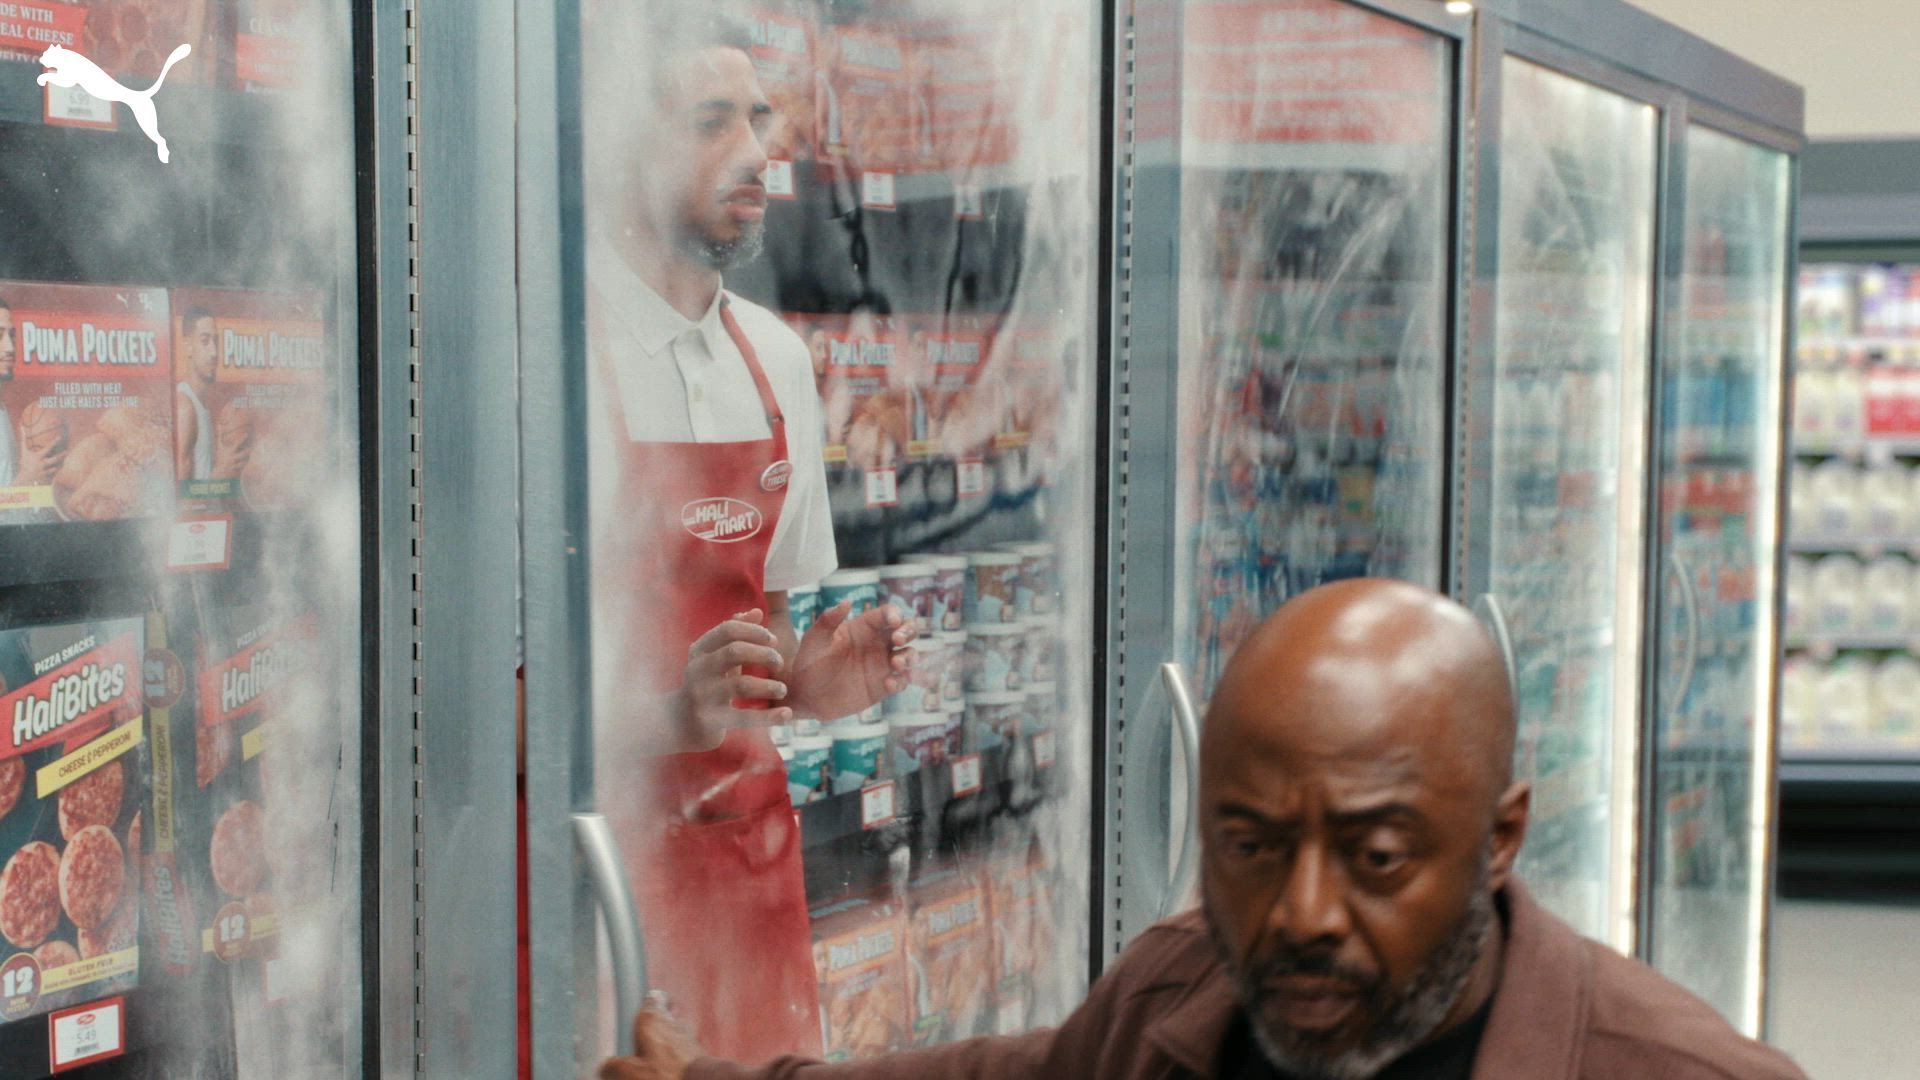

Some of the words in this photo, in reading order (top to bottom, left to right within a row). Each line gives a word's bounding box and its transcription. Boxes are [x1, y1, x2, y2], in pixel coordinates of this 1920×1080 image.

[20, 6, 53, 23] WITH
[0, 22, 24, 39] EAL
[27, 26, 74, 46] CHEESE
[22, 321, 79, 363] PUMA
[81, 322, 157, 364] POCKETS
[223, 328, 265, 367] PUMA
[38, 396, 58, 409] JUST
[59, 396, 77, 409] LIKE
[55, 382, 80, 396] FILLED
[82, 382, 101, 396] WITH
[692, 501, 729, 523] HALI
[714, 511, 755, 537] MART
[34, 651, 62, 676] PIZZA
[62, 635, 95, 662] SNACKS
[13, 663, 125, 746] HaliBites
[58, 755, 86, 778] CHEESE
[92, 731, 132, 762] PEPPERONI
[158, 796, 170, 840] CHEESE
[3, 966, 34, 998] 12
